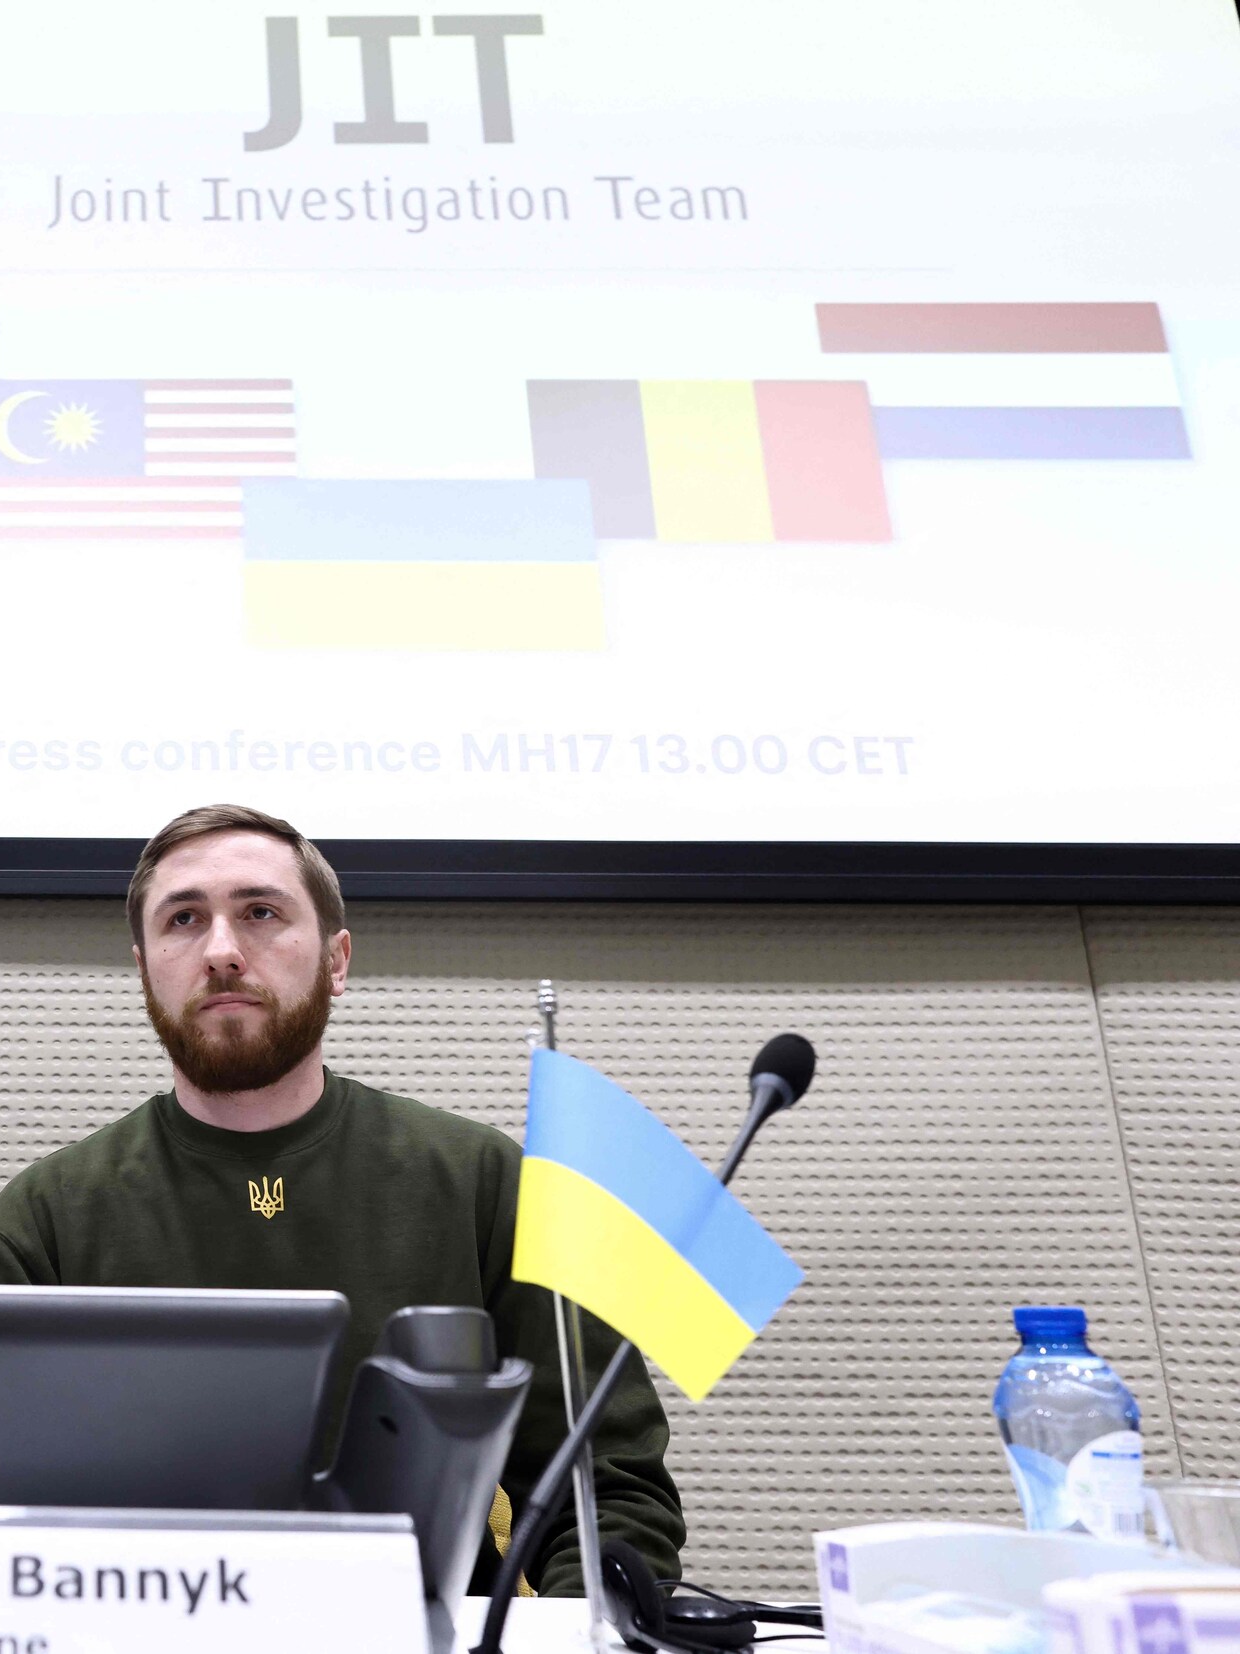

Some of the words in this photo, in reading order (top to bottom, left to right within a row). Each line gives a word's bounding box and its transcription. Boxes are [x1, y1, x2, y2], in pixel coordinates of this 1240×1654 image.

[242, 13, 546, 153] JIT
[47, 175, 171, 229] Joint
[202, 176, 570, 233] Investigation
[594, 176, 748, 221] Team
[120, 729, 441, 774] conference
[461, 733, 612, 774] MH17
[630, 733, 789, 775] 13.00
[807, 735, 916, 776] CET
[11, 1554, 251, 1615] Bannyk
